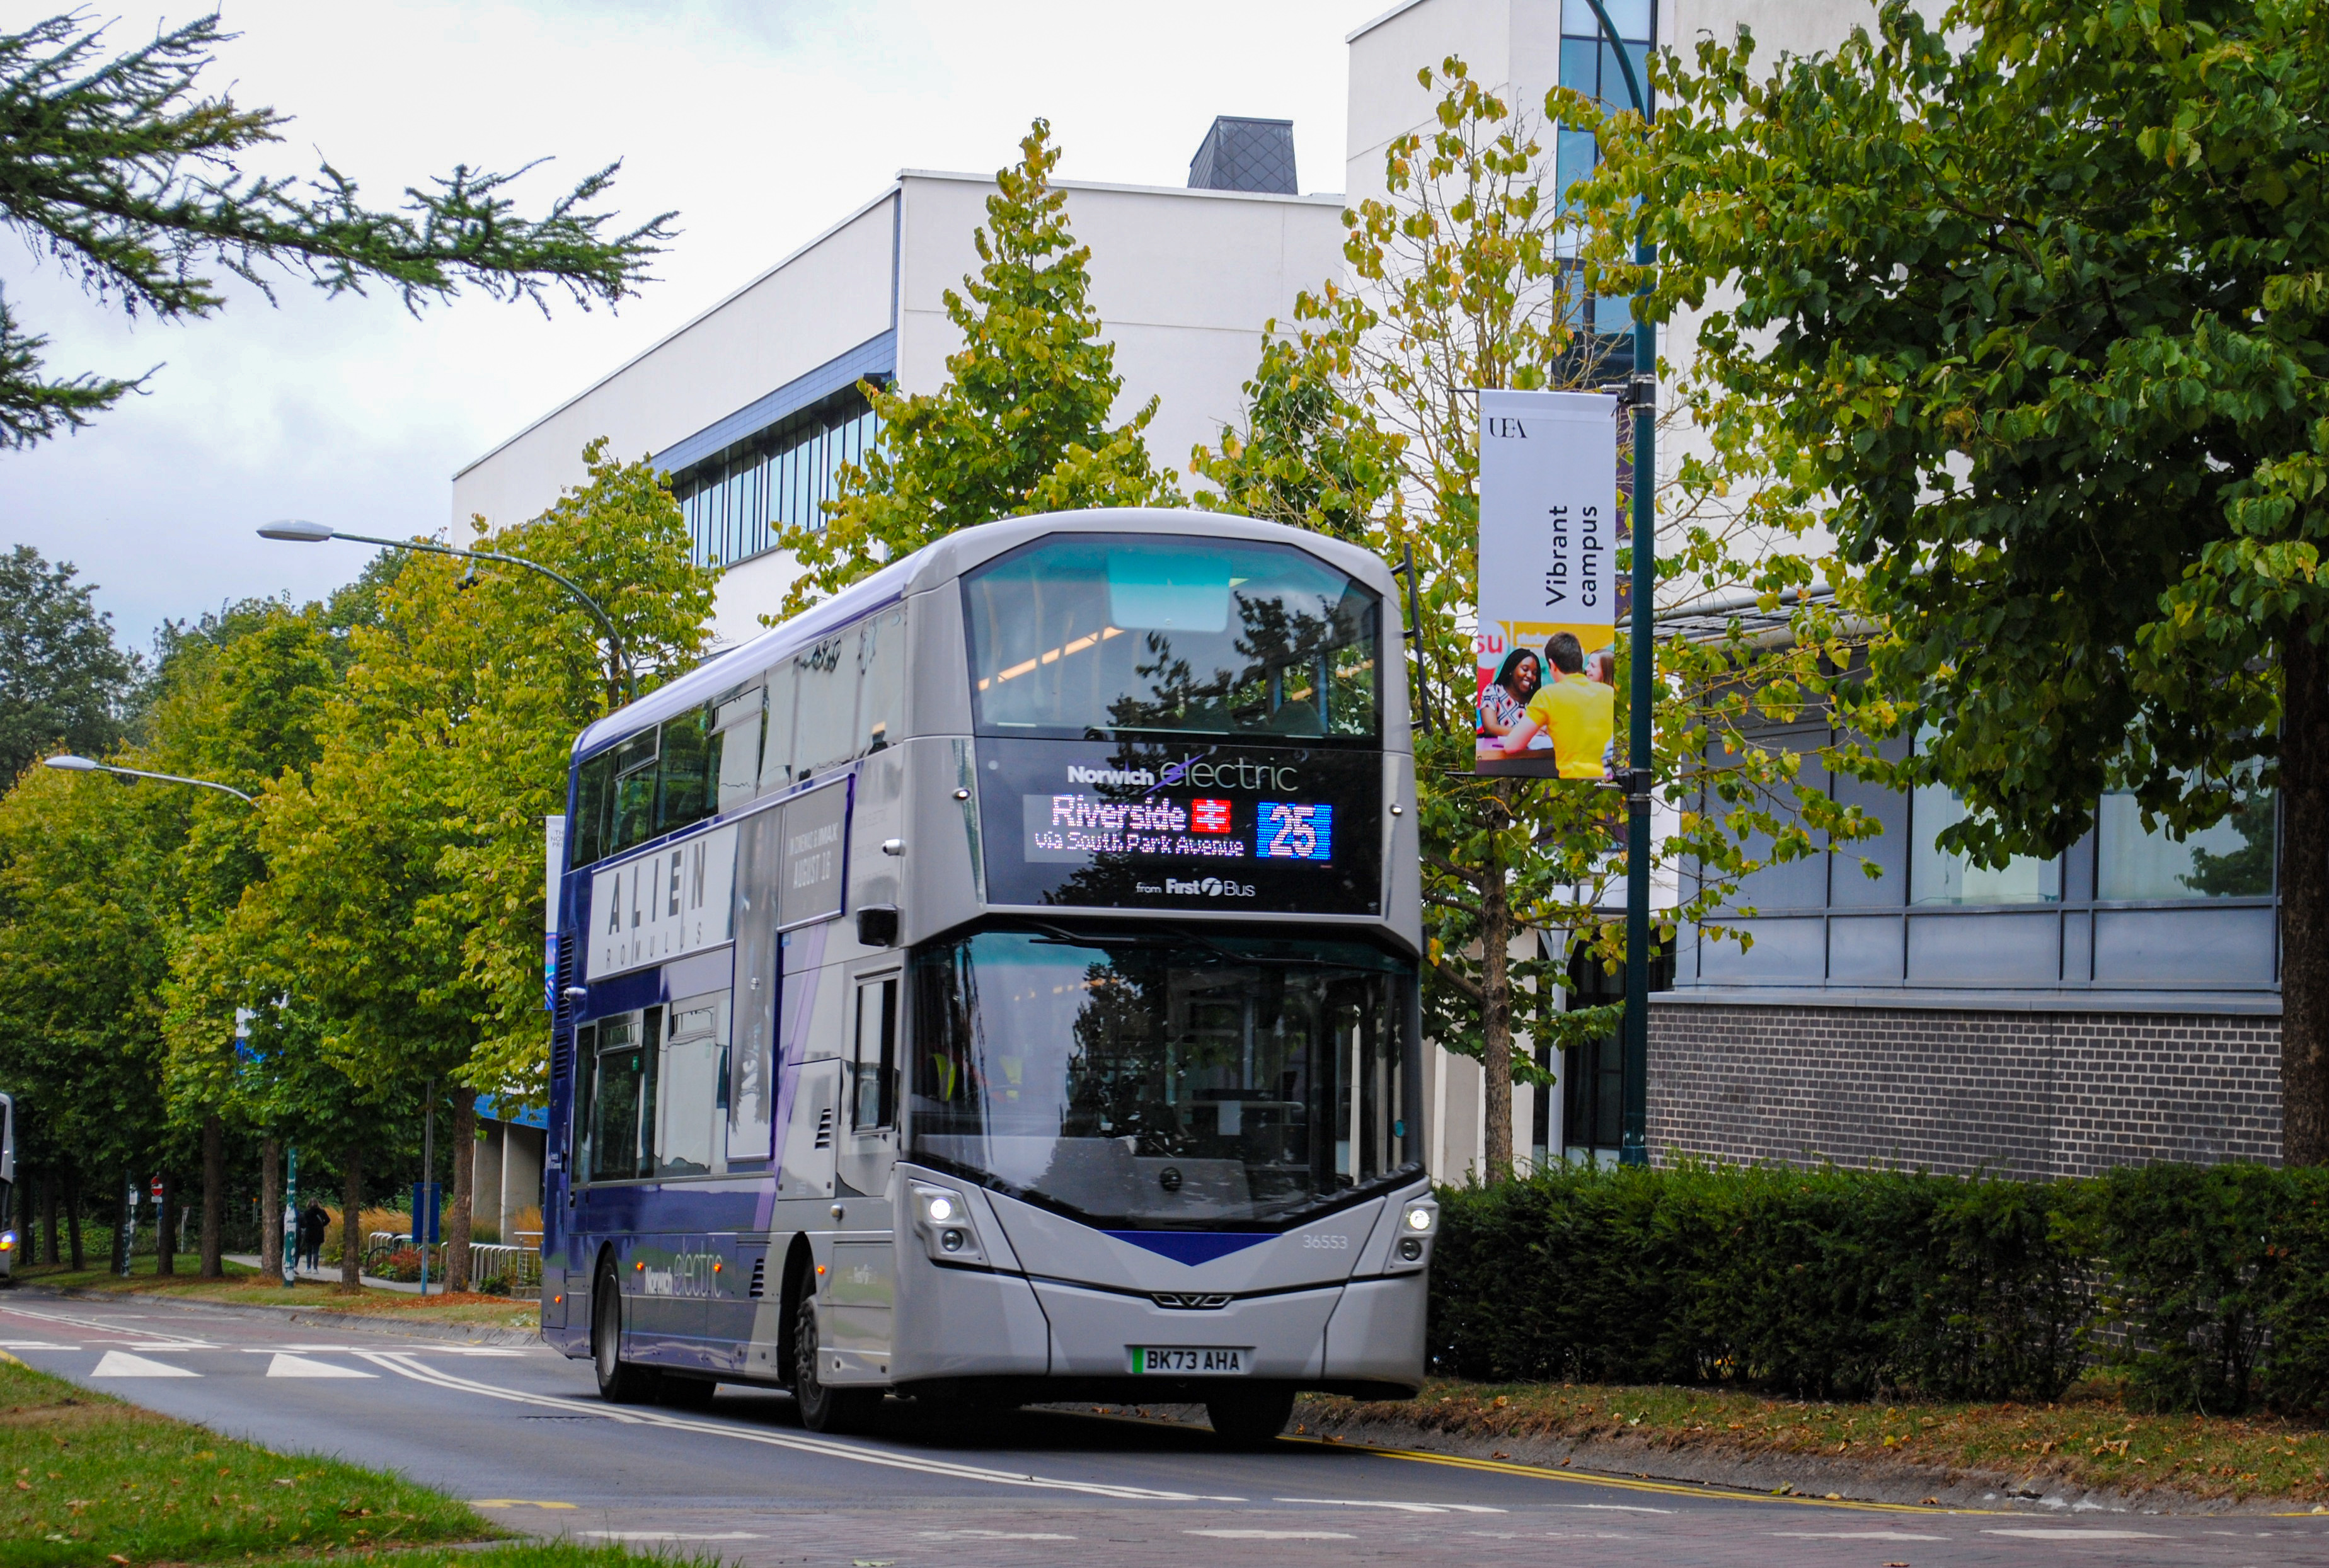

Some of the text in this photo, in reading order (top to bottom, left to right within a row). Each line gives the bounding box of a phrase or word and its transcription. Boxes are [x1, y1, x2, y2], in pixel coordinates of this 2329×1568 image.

[1488, 417, 1527, 439] UEA
[1545, 505, 1568, 607] Vibrant
[1582, 506, 1604, 607] campus
[1067, 752, 1299, 791] Norwich electric
[1052, 794, 1187, 832] Riverside
[1268, 804, 1316, 857] 25
[1035, 831, 1245, 857] via South Park Avenue
[607, 840, 706, 936] ALIEN
[1136, 878, 1256, 897] from First Bus
[606, 922, 702, 970] ROMULUS
[1303, 1234, 1349, 1250] 36553
[645, 1236, 723, 1298] Norwich electric
[1146, 1350, 1240, 1371] BK73 AHA
